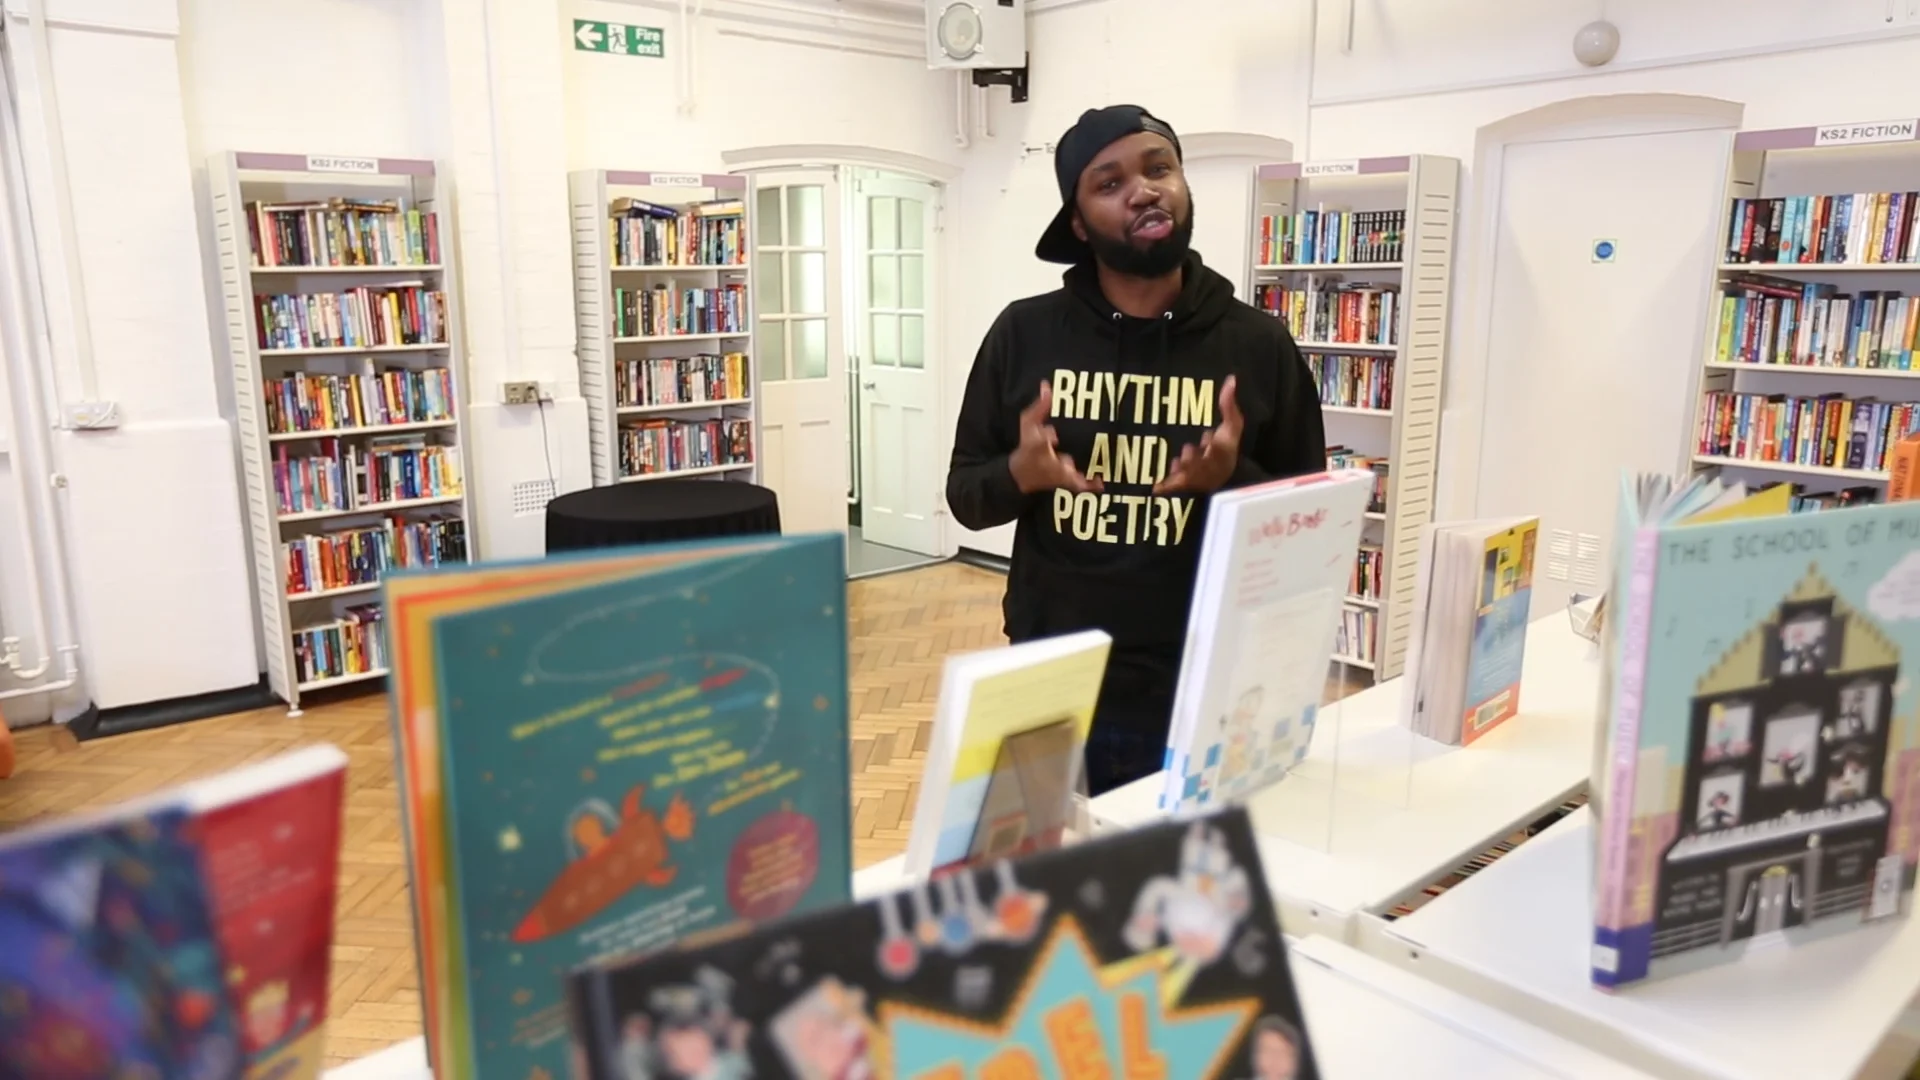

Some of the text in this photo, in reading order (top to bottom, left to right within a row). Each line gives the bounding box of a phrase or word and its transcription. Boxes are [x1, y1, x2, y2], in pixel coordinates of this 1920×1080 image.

[635, 28, 661, 42] Fire
[637, 43, 661, 55] exit
[1820, 124, 1913, 141] KS2 FICTION
[333, 159, 375, 170] FICTION
[1322, 163, 1354, 173] FICTION
[669, 176, 700, 185] FICTION
[1051, 368, 1215, 428] RHYTHM
[1086, 432, 1169, 486] AND
[1053, 487, 1196, 547] POETRY
[1668, 537, 1713, 566] THE
[1730, 526, 1830, 561] SCHOOL
[1845, 519, 1877, 548] OF
